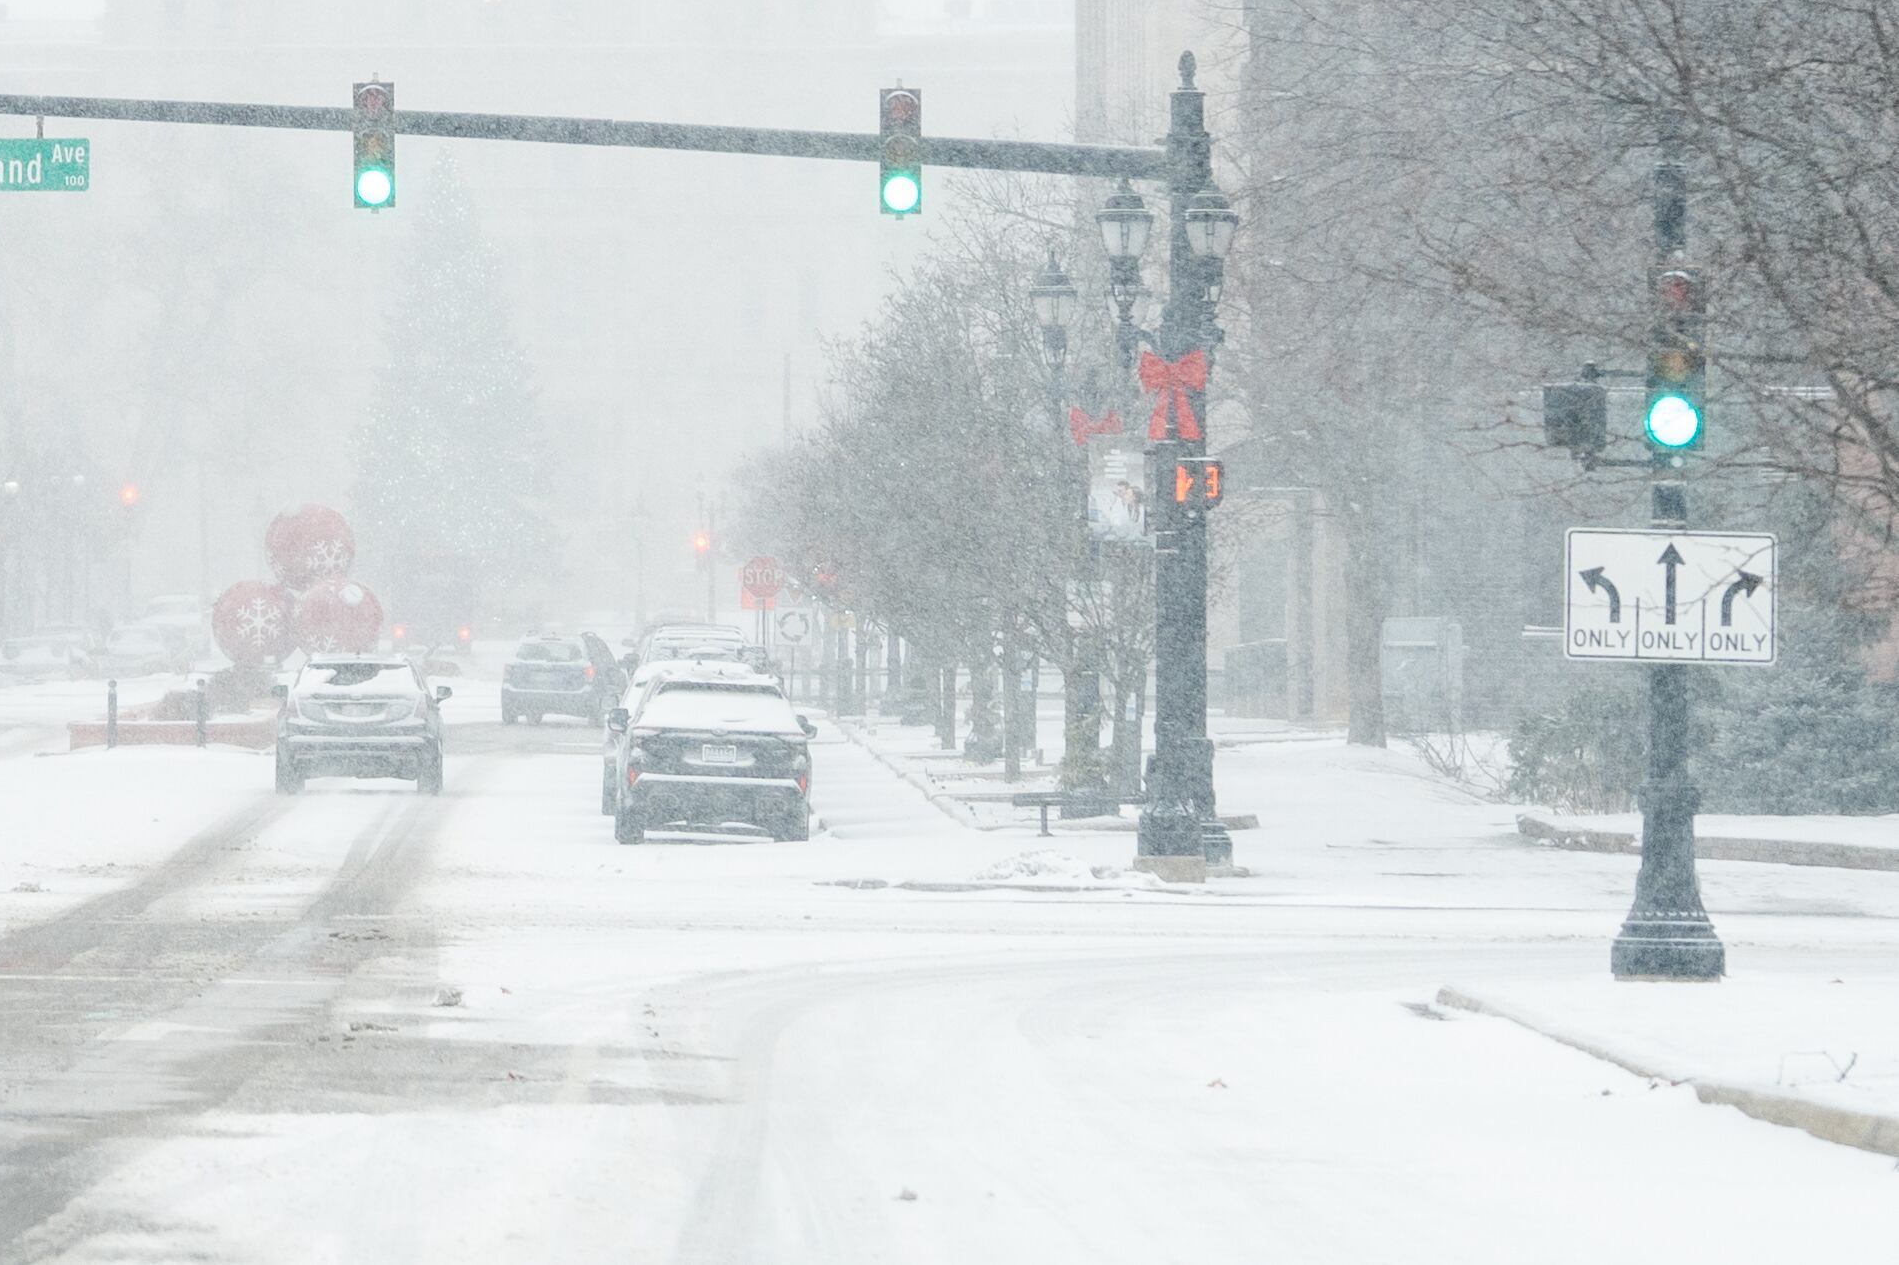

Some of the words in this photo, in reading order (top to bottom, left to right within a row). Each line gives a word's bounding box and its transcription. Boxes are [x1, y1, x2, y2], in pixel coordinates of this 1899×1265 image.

[52, 143, 86, 164] Ave
[64, 175, 86, 187] 100
[744, 568, 784, 586] STOP
[1573, 628, 1631, 649] ONLY
[1641, 630, 1699, 651] ONLY
[1709, 632, 1768, 652] ONLY
